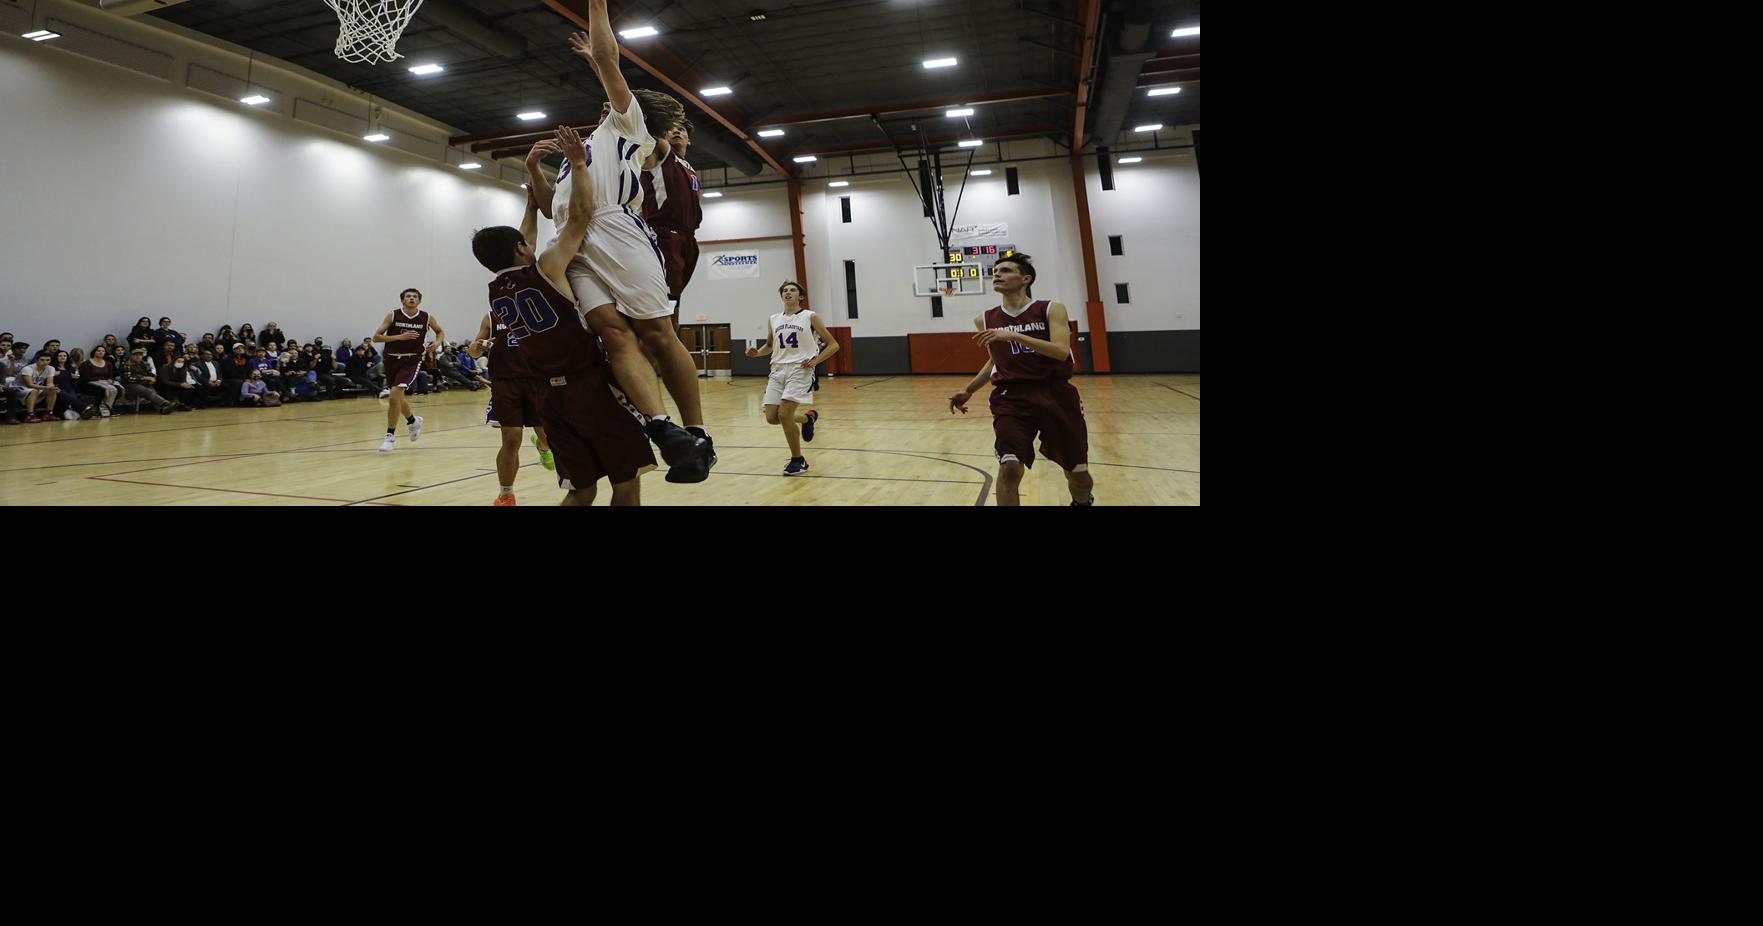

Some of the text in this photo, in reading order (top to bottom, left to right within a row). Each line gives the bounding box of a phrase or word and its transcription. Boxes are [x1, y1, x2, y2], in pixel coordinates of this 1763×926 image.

[949, 253, 962, 262] 30
[492, 287, 559, 340] 20
[778, 331, 799, 349] 14
